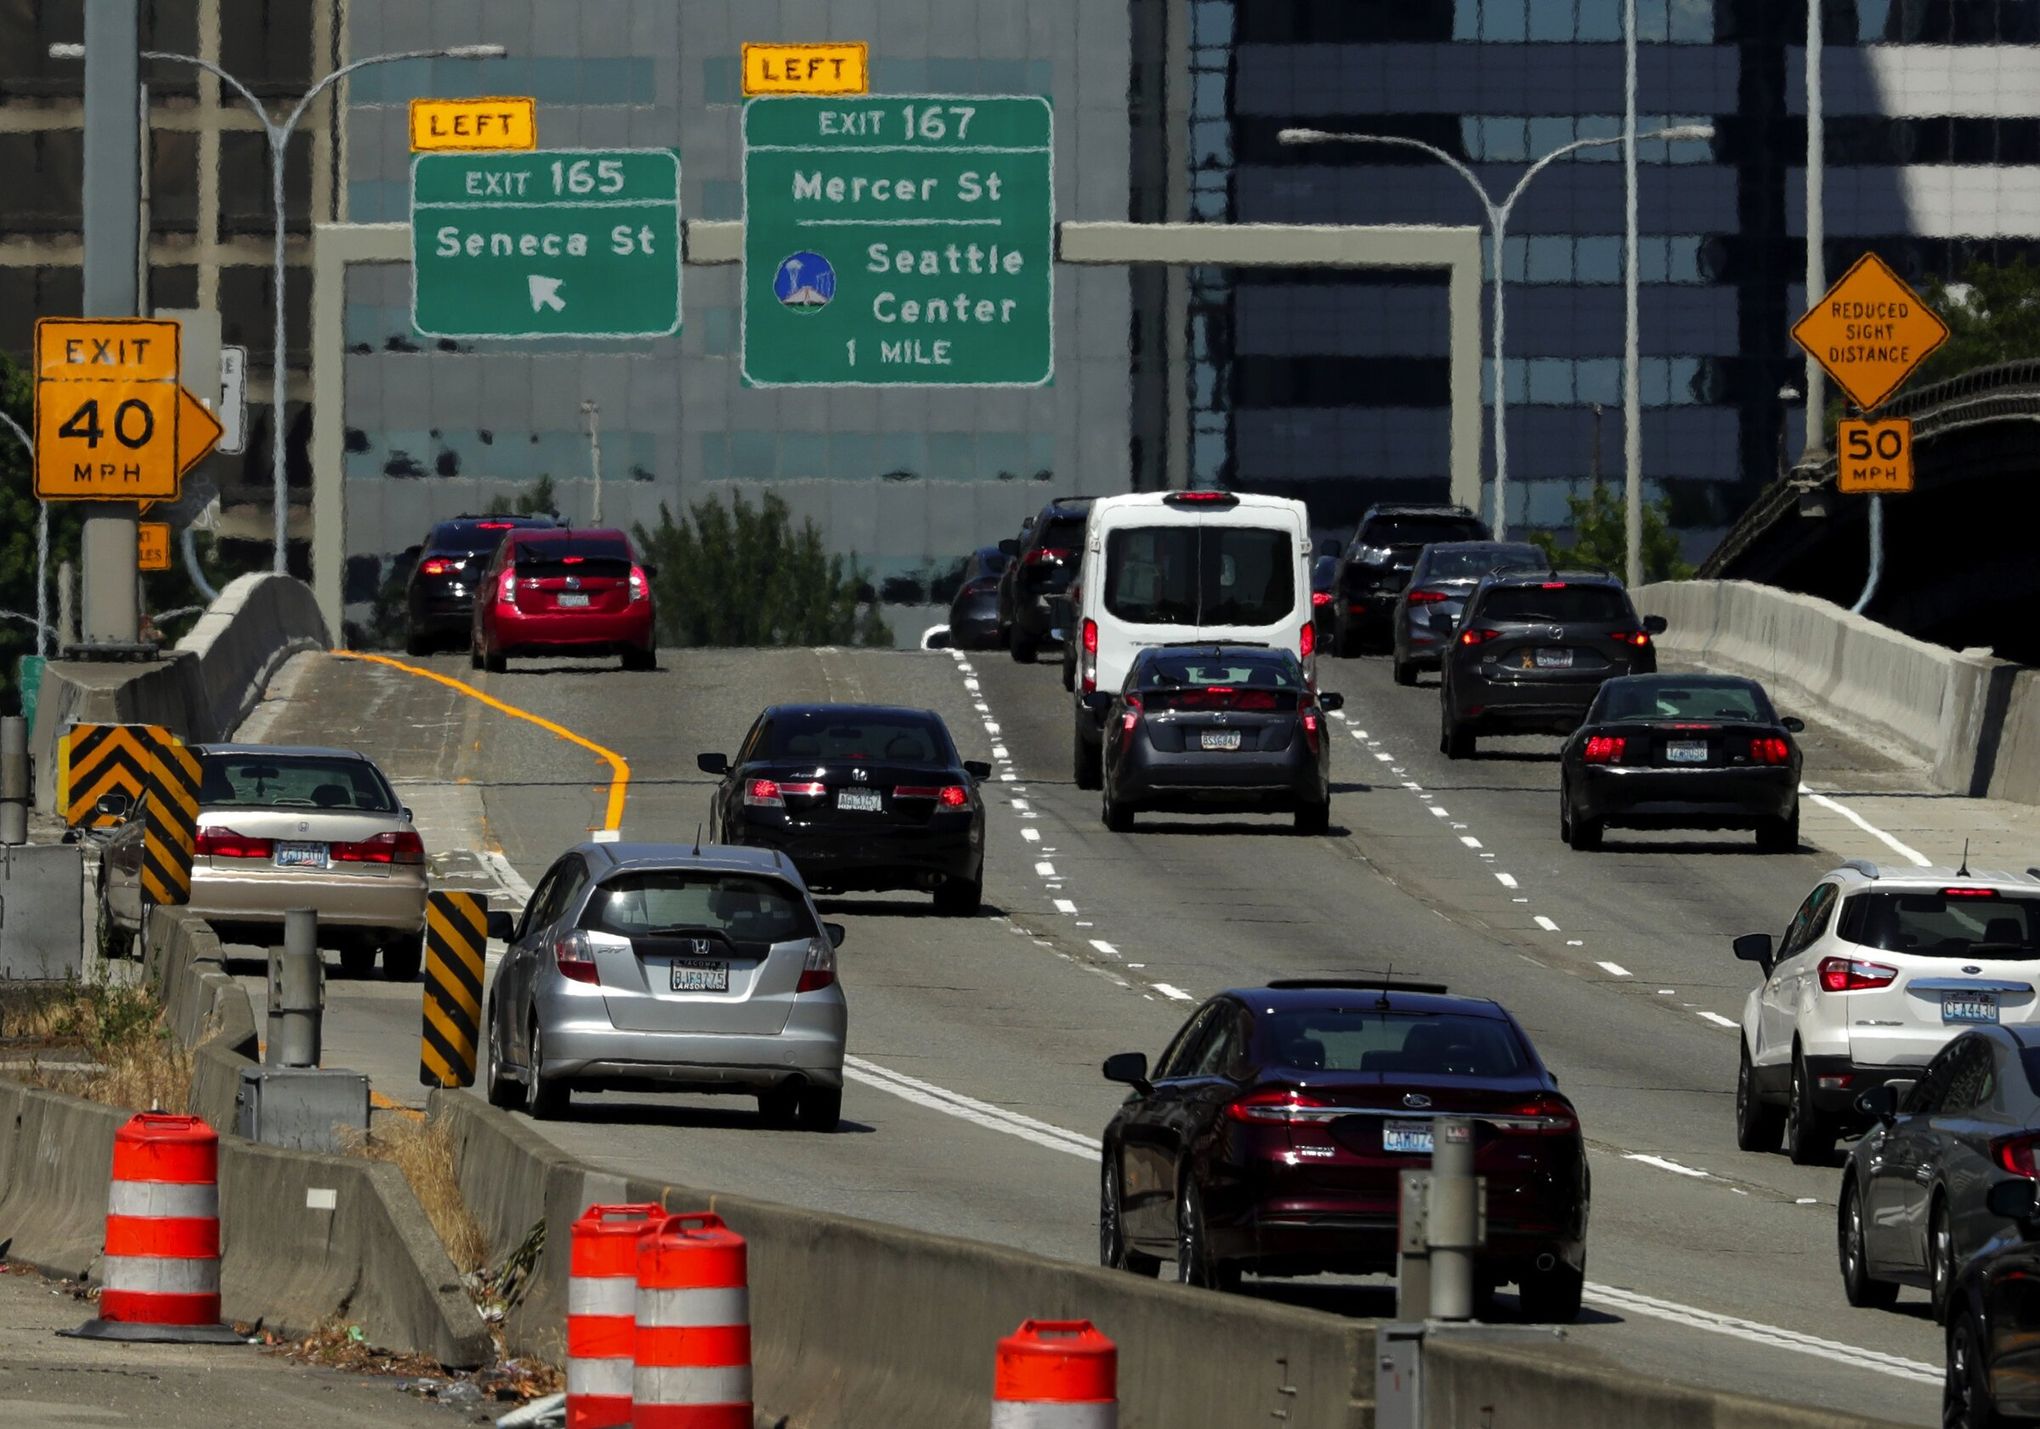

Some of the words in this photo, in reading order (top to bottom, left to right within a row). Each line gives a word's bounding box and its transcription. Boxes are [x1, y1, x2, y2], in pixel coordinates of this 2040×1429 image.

[762, 57, 846, 81] LEFT
[430, 113, 513, 137] LEFT
[818, 110, 886, 135] EXIT
[902, 104, 975, 140] 167
[465, 171, 532, 196] EXIT
[551, 159, 625, 196] 165
[792, 170, 938, 202] Mercer
[957, 171, 1002, 202] St
[436, 225, 588, 257] Seneca
[611, 224, 655, 256] St
[866, 243, 1024, 275] Seattle
[872, 291, 1016, 323] Center
[1832, 302, 1909, 318] REDUCED
[1846, 323, 1894, 340] SIGHT
[66, 338, 151, 364] EXIT
[846, 338, 856, 366] 1
[880, 338, 951, 365] MILE
[1829, 347, 1910, 362] DISTANCE
[59, 398, 154, 449] 40
[1848, 429, 1902, 460] 50
[74, 463, 140, 482] MPH
[1853, 466, 1897, 481] MPH
